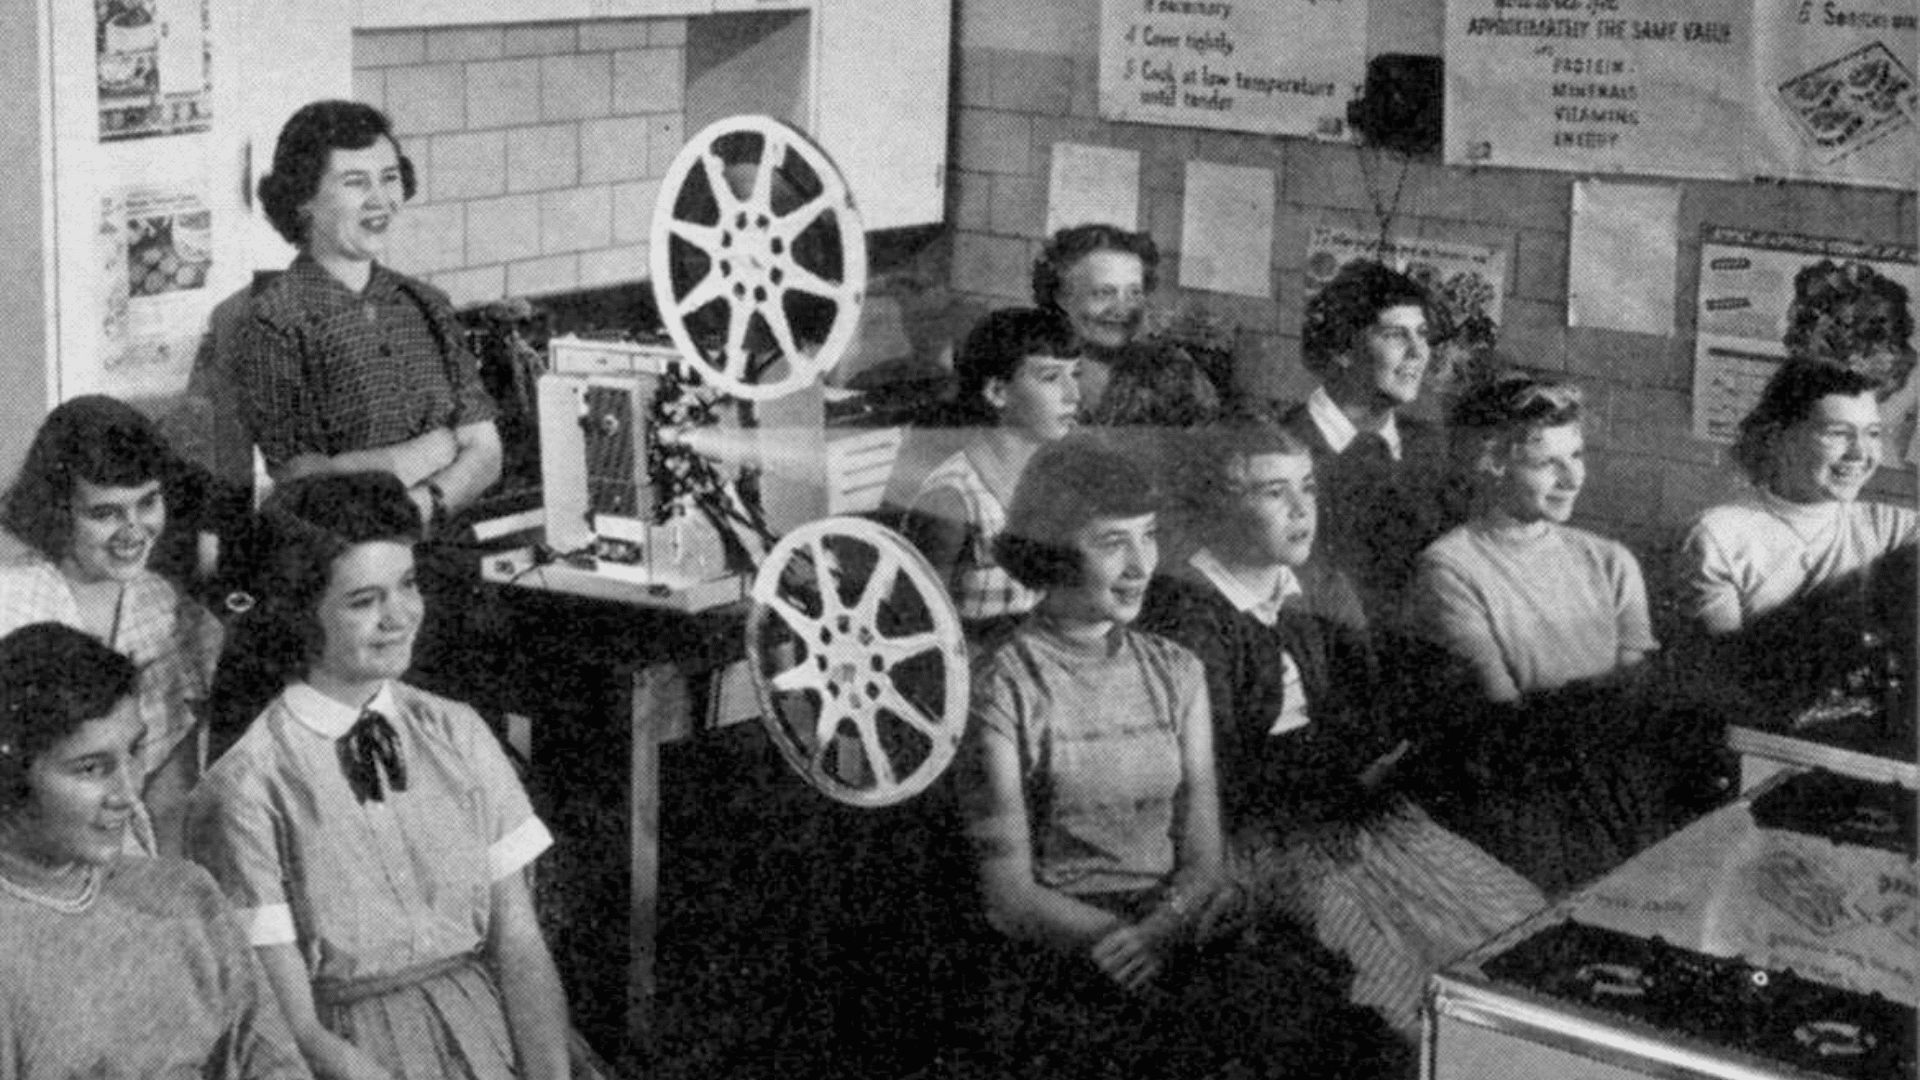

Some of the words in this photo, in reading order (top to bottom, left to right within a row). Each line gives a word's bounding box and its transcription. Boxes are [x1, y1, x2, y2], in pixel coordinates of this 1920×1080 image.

[1597, 18, 1627, 38] THE
[1632, 19, 1677, 41] SAME
[1683, 21, 1732, 44] VALUE
[1182, 69, 1196, 84] at
[1202, 65, 1230, 86] low
[1236, 72, 1335, 96] temperature
[1552, 83, 1638, 100] MINERALS
[1554, 105, 1640, 125] VITAMINS
